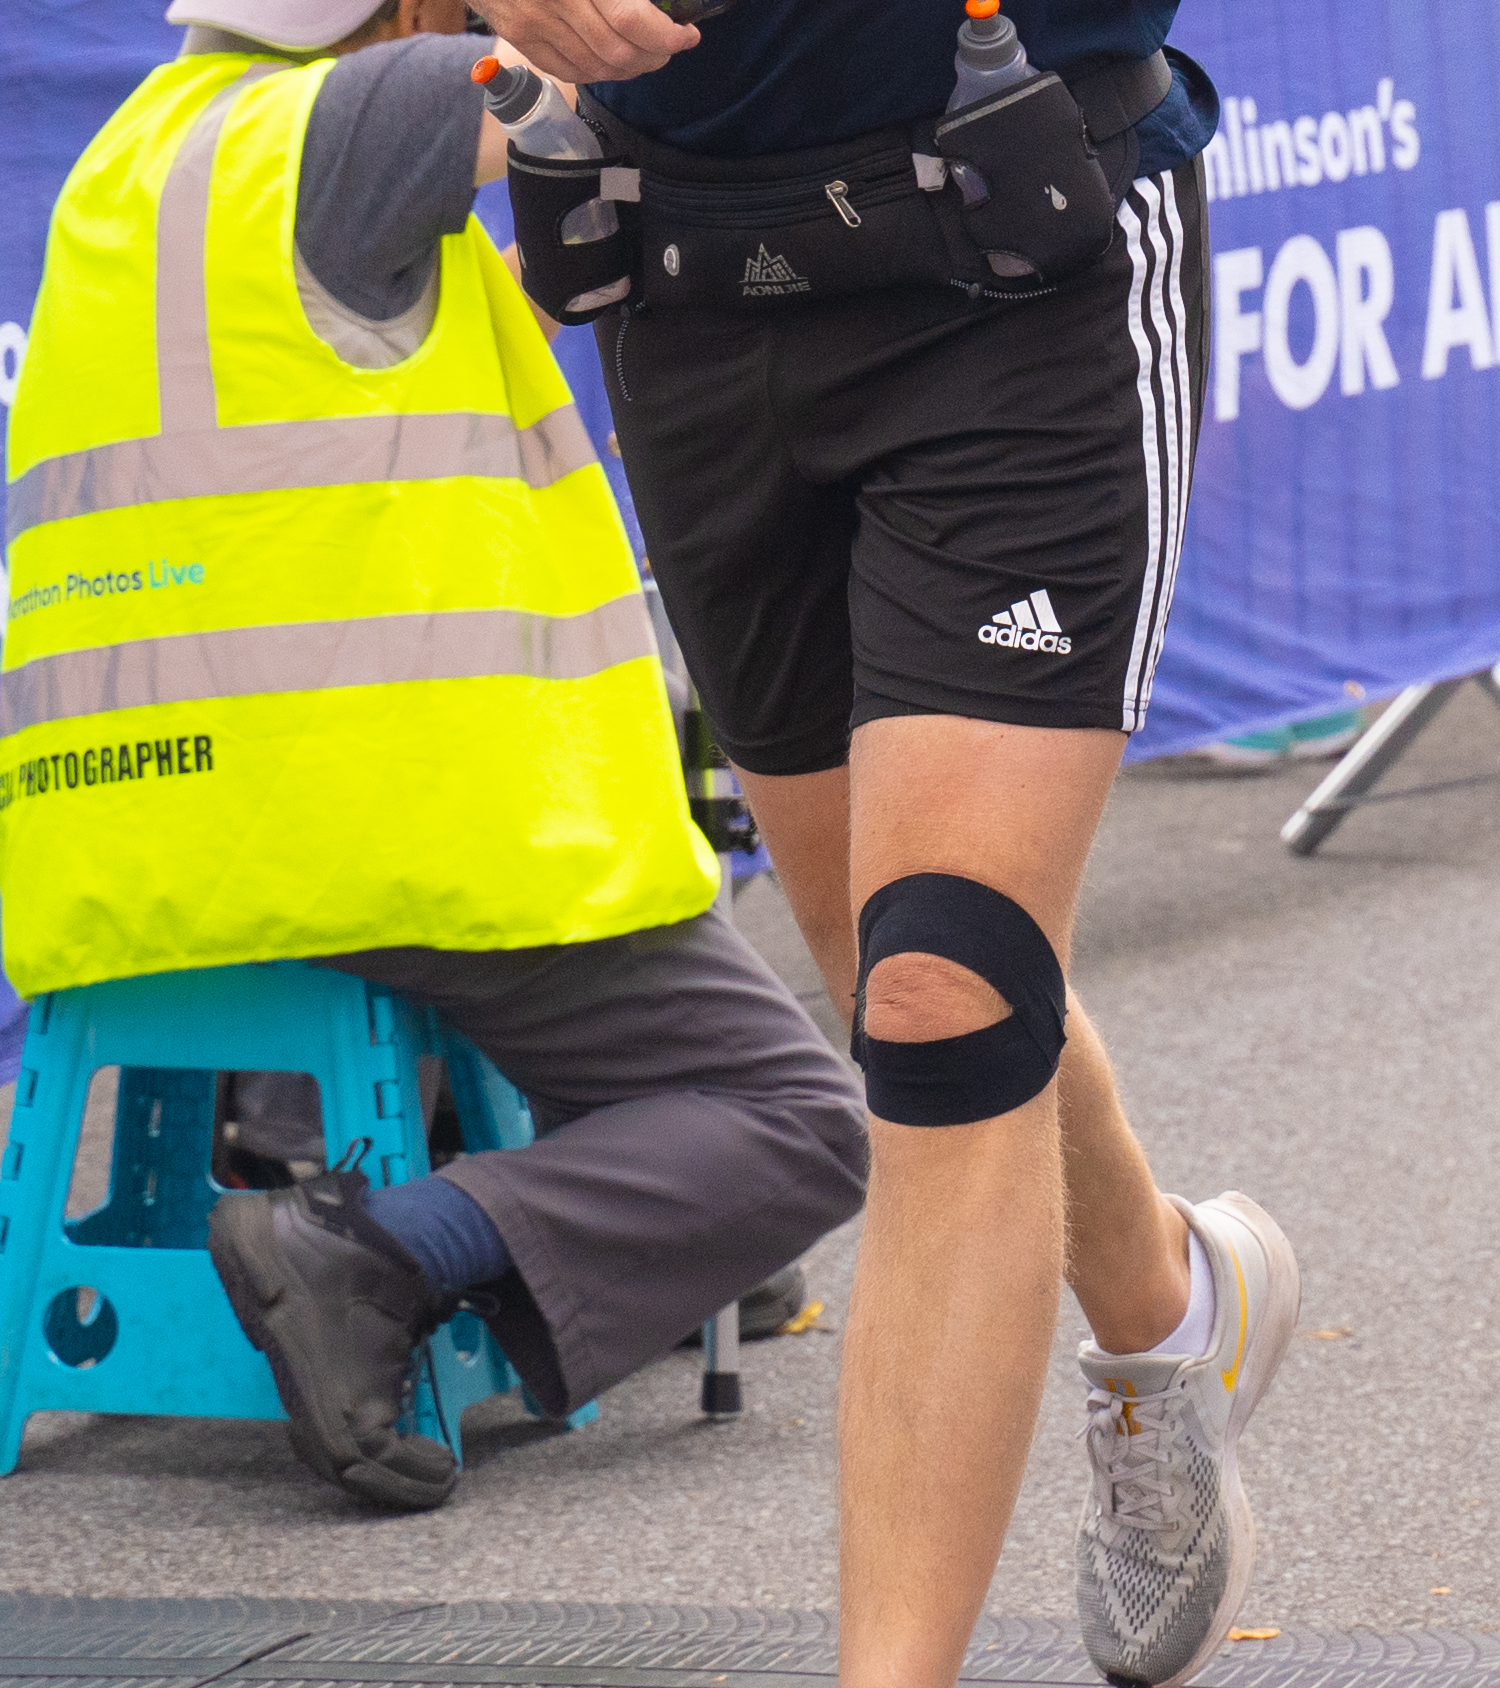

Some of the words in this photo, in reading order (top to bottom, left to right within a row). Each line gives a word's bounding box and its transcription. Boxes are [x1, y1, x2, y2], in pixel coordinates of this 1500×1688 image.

[1214, 225, 1400, 423] FOR
[66, 570, 142, 600] Photos
[148, 559, 205, 588] Live
[978, 624, 1072, 654] adidas
[18, 735, 214, 800] PHOTOGRAPHER
